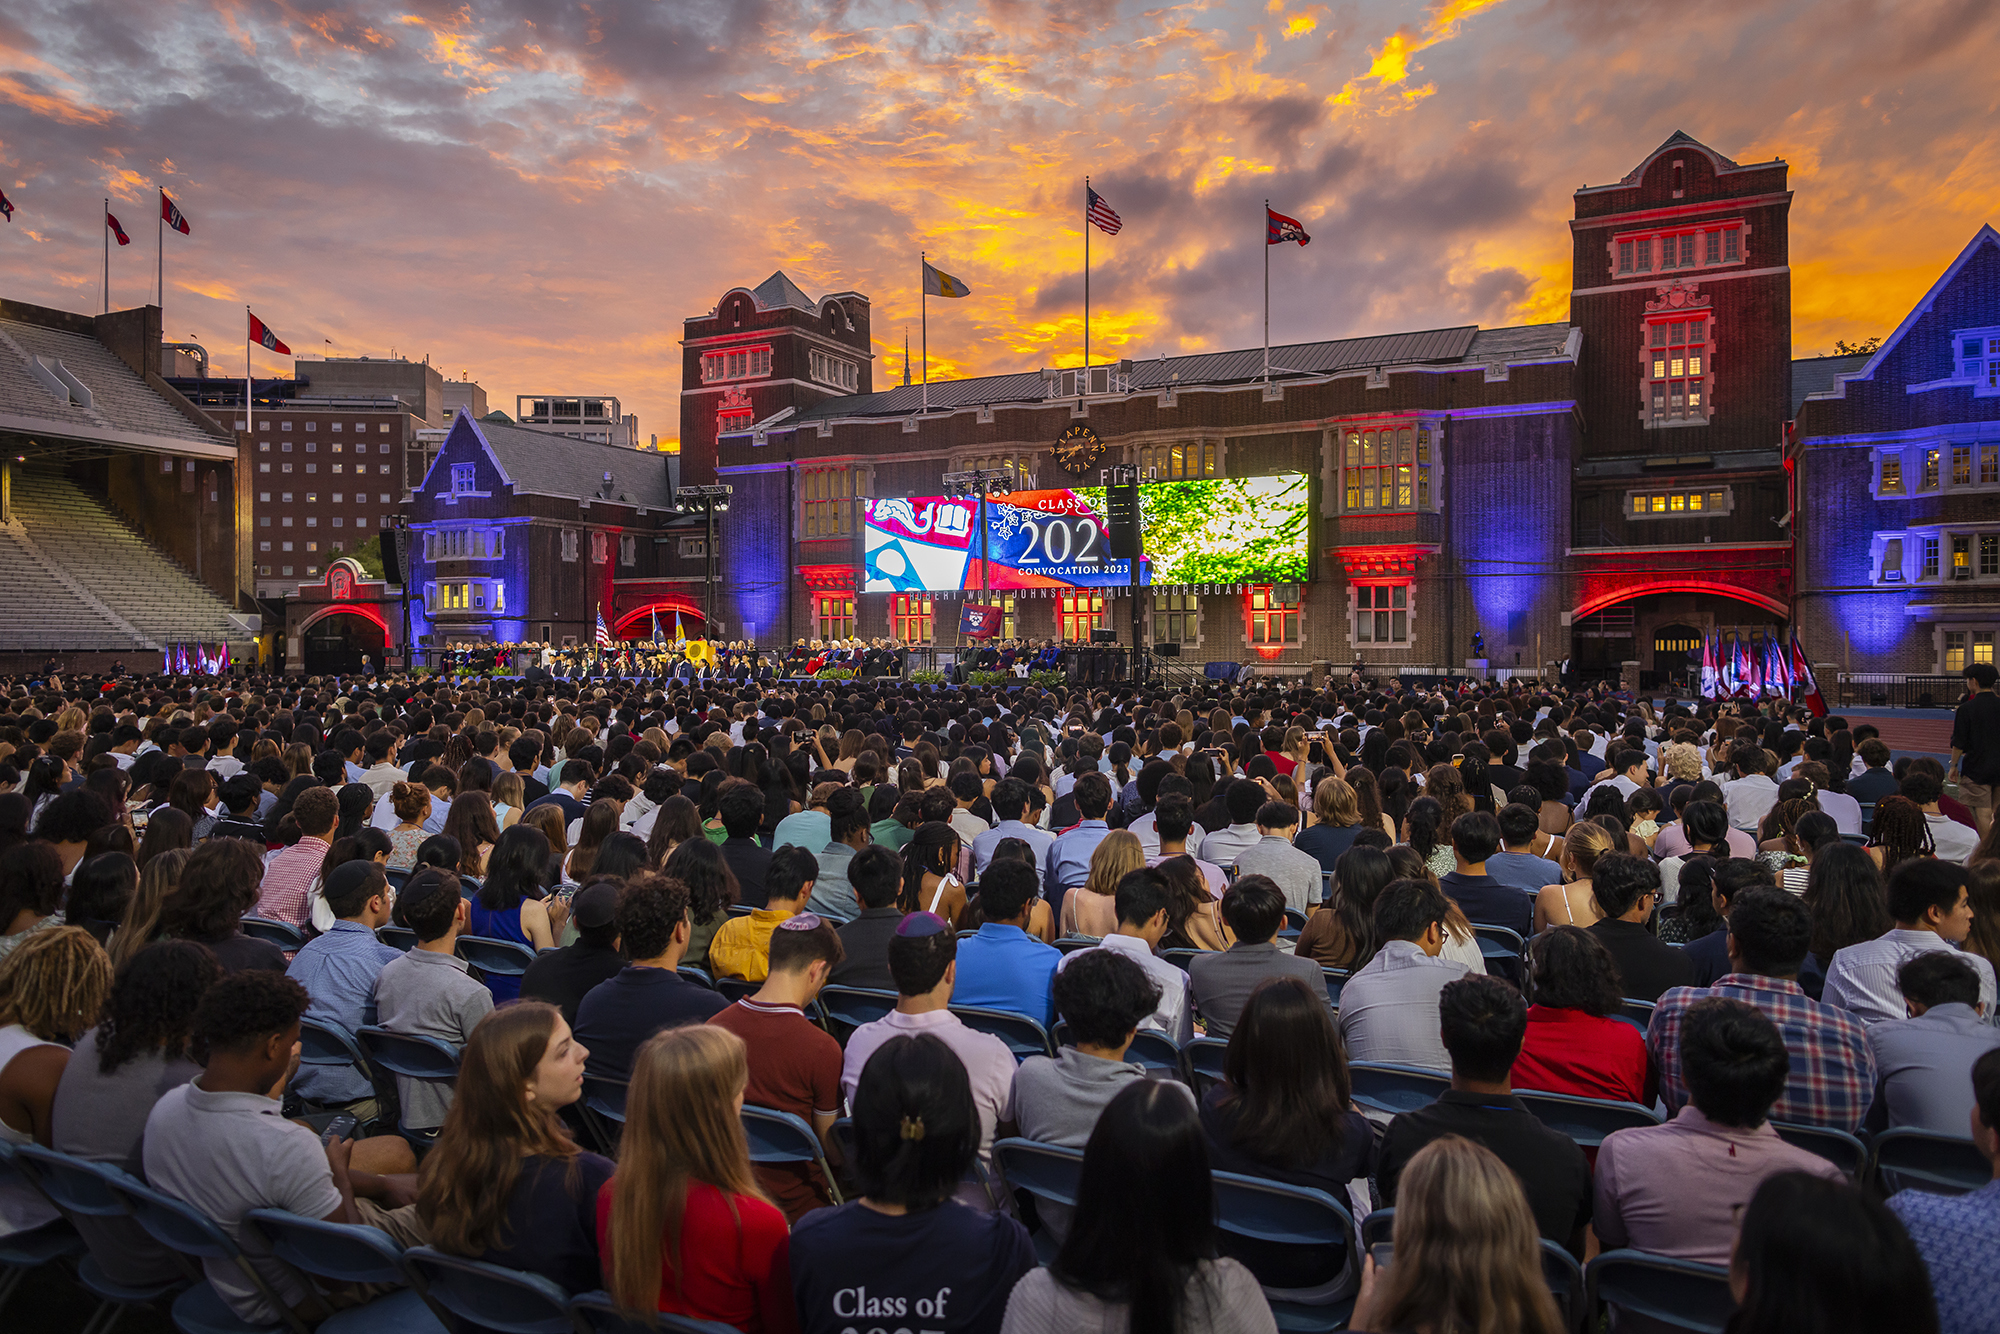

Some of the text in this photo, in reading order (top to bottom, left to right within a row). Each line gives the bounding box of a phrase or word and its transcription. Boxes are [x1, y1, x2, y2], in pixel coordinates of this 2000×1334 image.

[1038, 497, 1107, 510] CLASS OF
[1018, 518, 1117, 564] 202
[1018, 565, 1129, 576] CONVOCATION 2023
[909, 590, 957, 601] ROBERT
[1012, 587, 1076, 599] JOHNSON
[1088, 585, 1132, 598] FAMIL
[1153, 583, 1255, 597] SCOREBOARD
[832, 1286, 952, 1319] Class of
